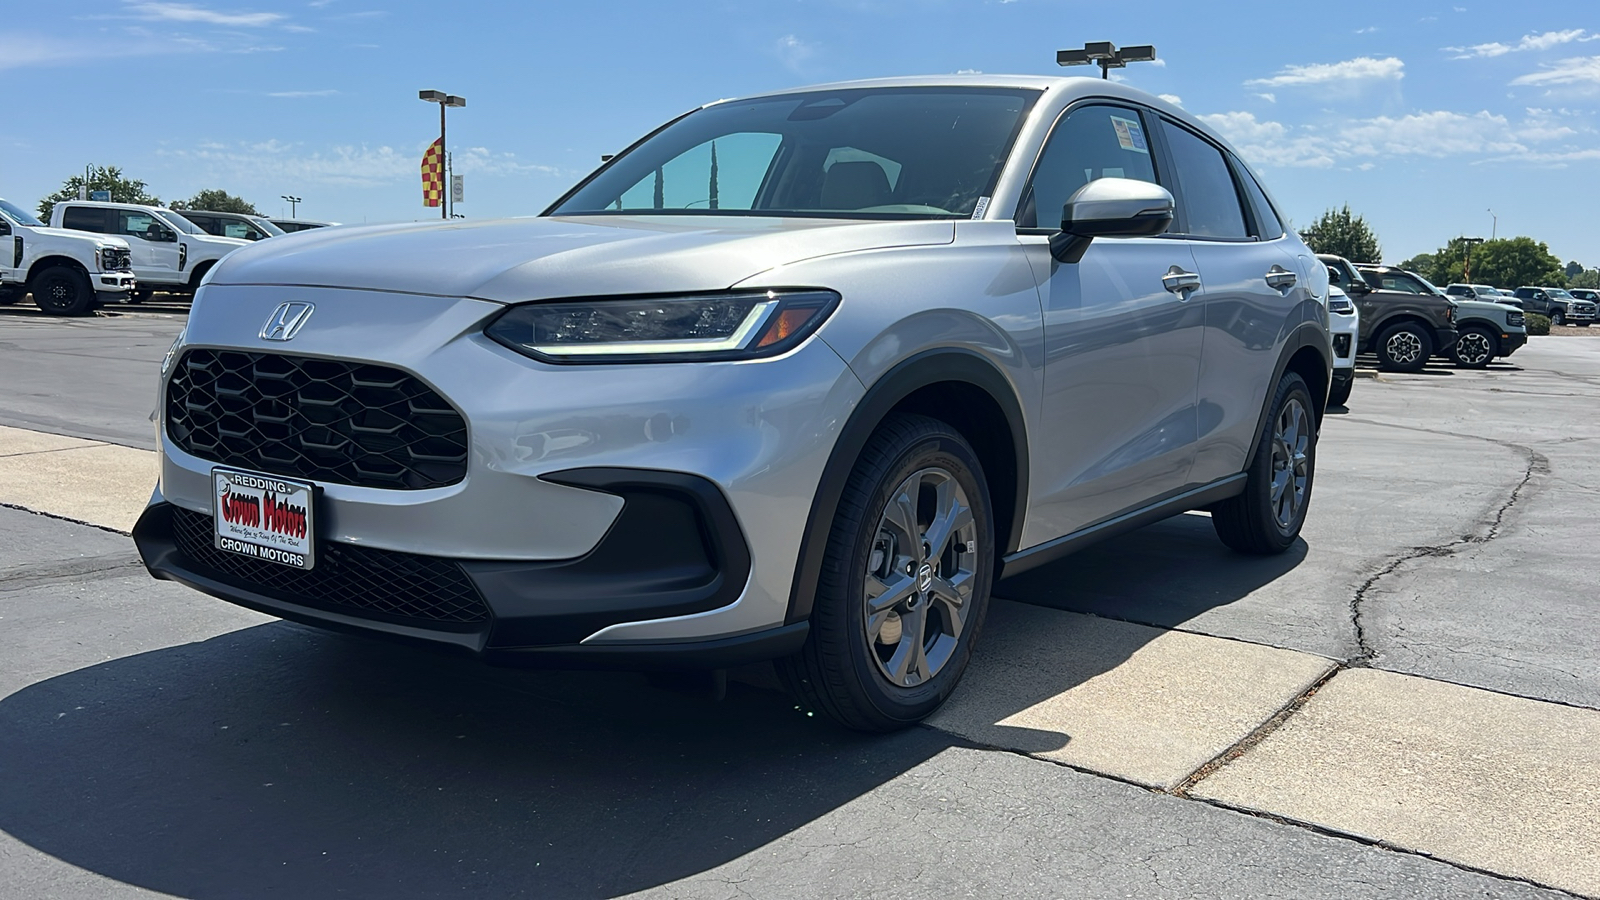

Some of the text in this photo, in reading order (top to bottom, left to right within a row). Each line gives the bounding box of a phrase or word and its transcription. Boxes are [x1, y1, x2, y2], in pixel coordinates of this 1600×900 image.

[235, 475, 286, 493] REDDING
[221, 484, 307, 539] Crown Motors
[220, 537, 304, 567] CROWN MOTORS
